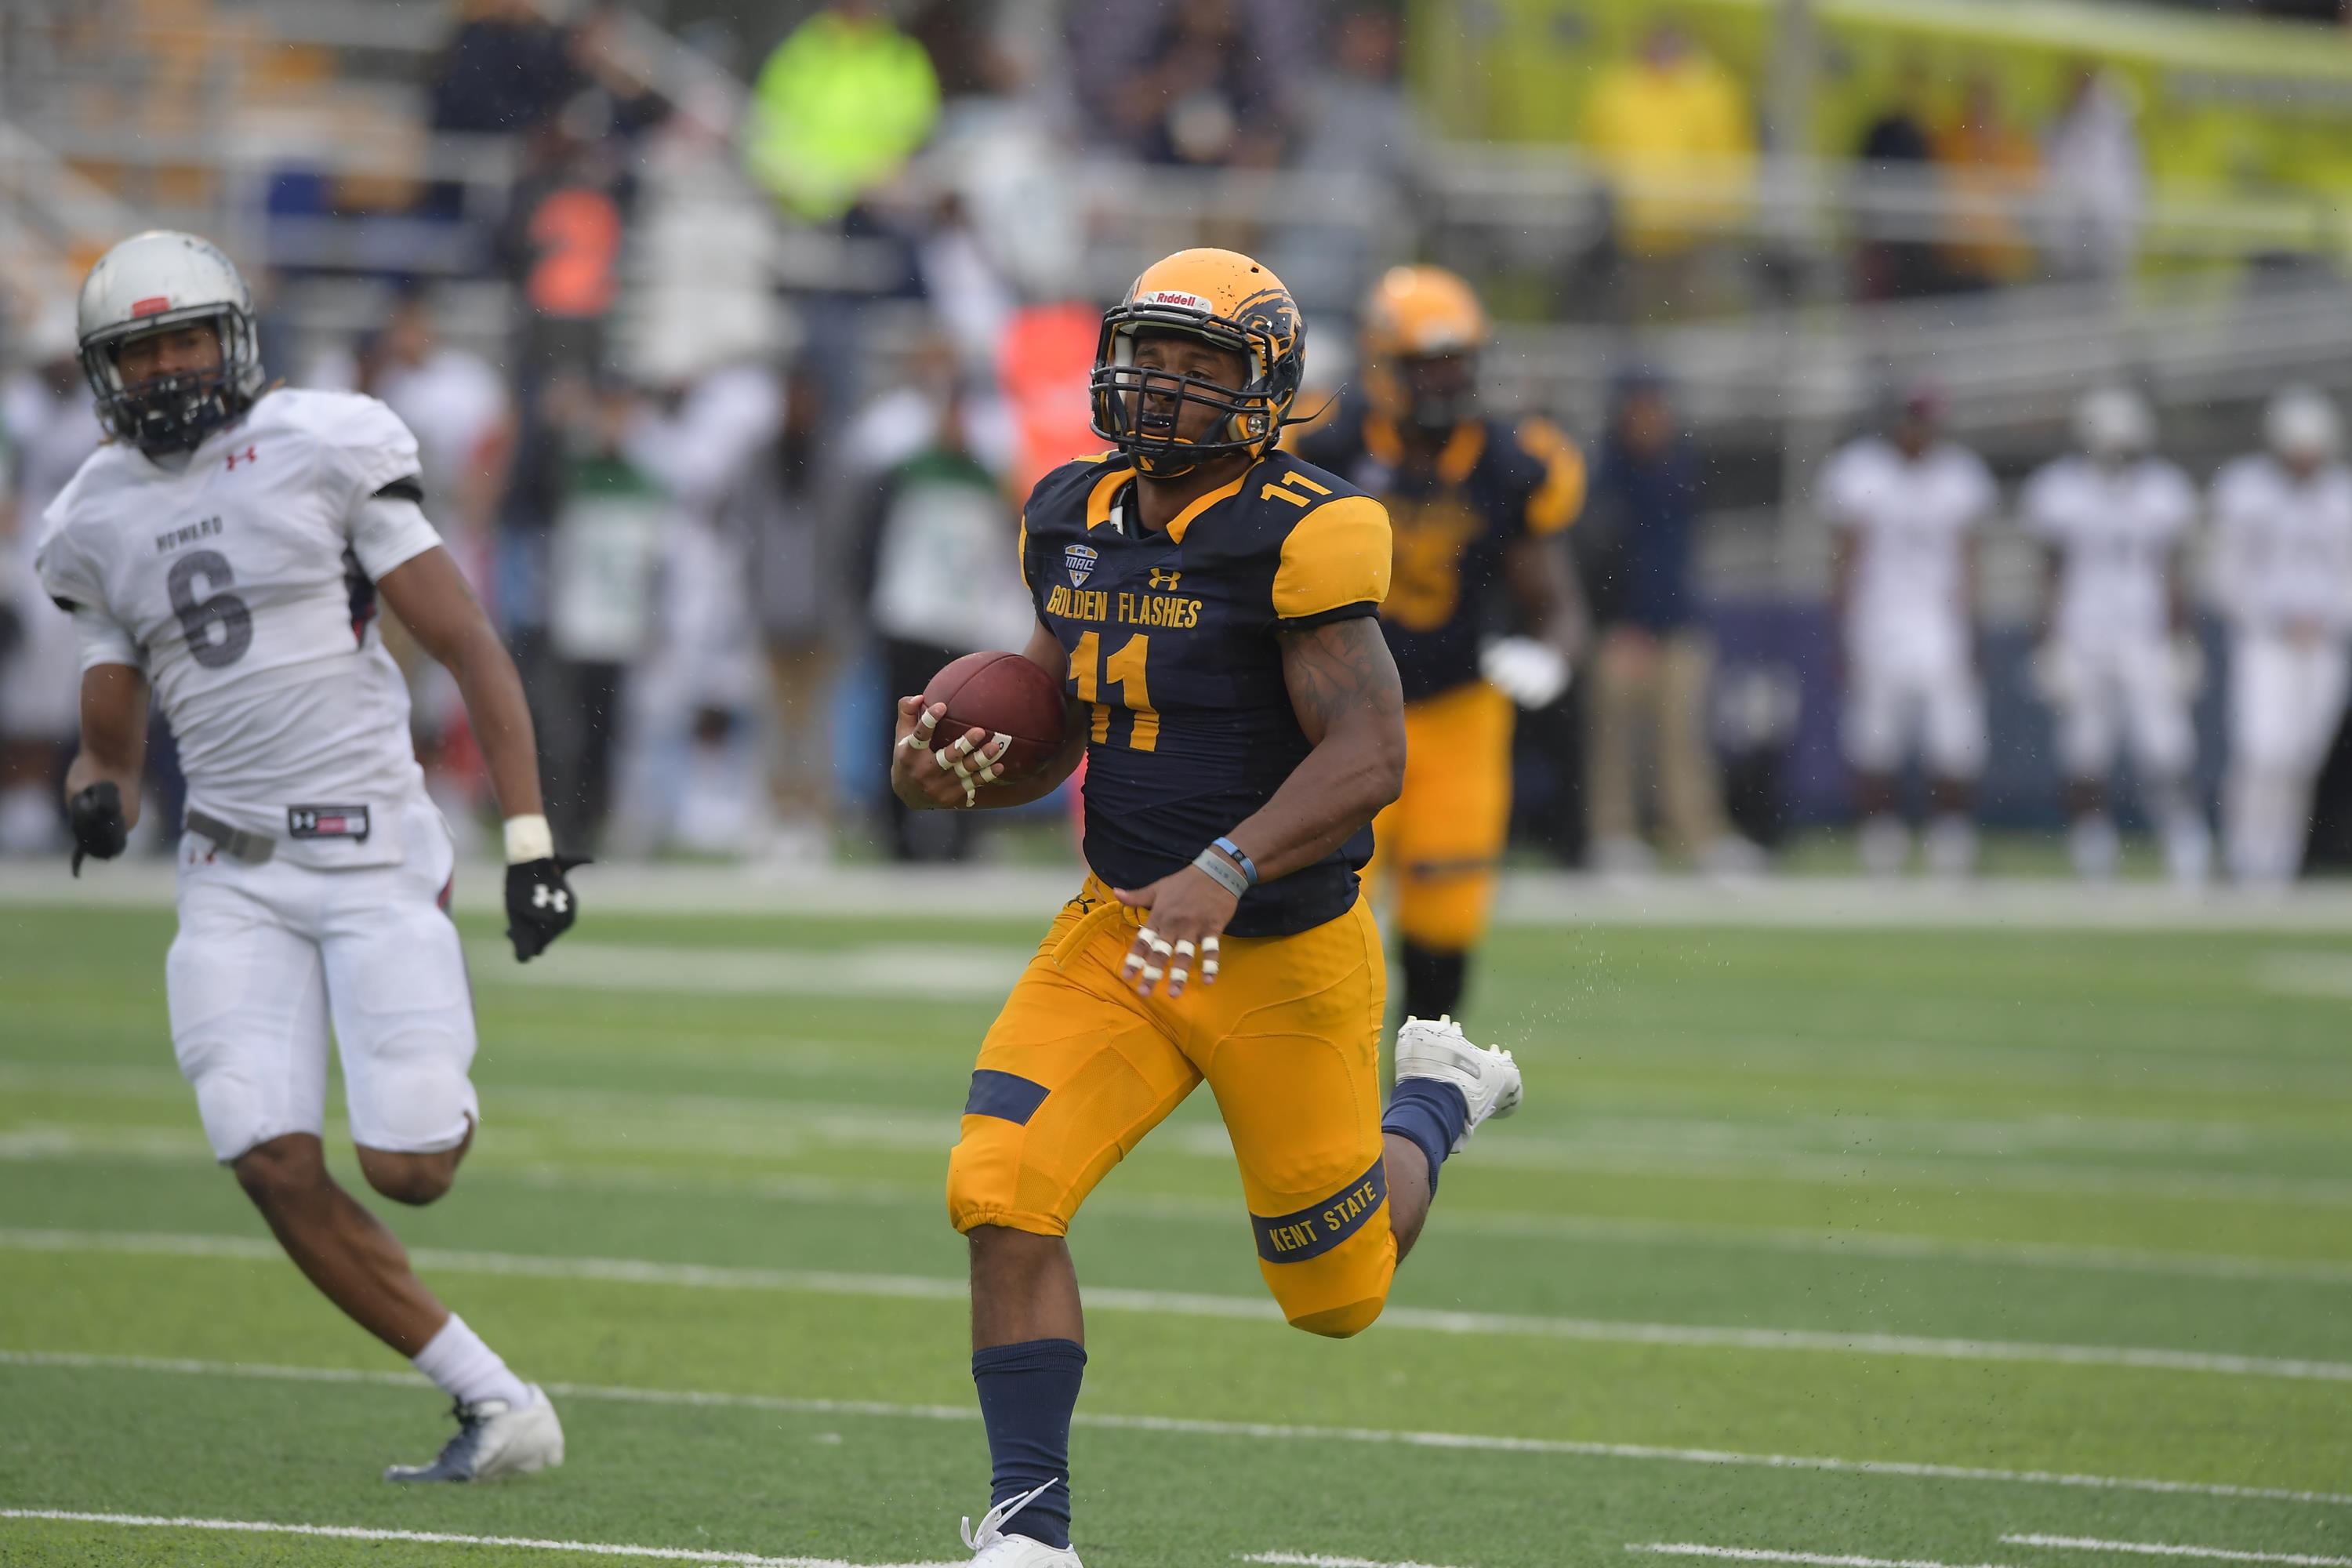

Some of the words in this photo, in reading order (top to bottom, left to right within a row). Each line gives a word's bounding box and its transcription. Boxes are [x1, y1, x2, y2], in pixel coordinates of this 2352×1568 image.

[1156, 292, 1196, 307] Riddell
[1260, 470, 1334, 508] 11
[156, 515, 223, 552] HOWARD
[1065, 556, 1096, 572] MAC
[167, 550, 254, 670] 6
[1046, 585, 1109, 622] GOLDEN
[1118, 592, 1203, 629] FLASHES
[1069, 630, 1160, 753] 11
[1269, 1220, 1318, 1252] KENT
[1323, 1181, 1377, 1231] STATE
